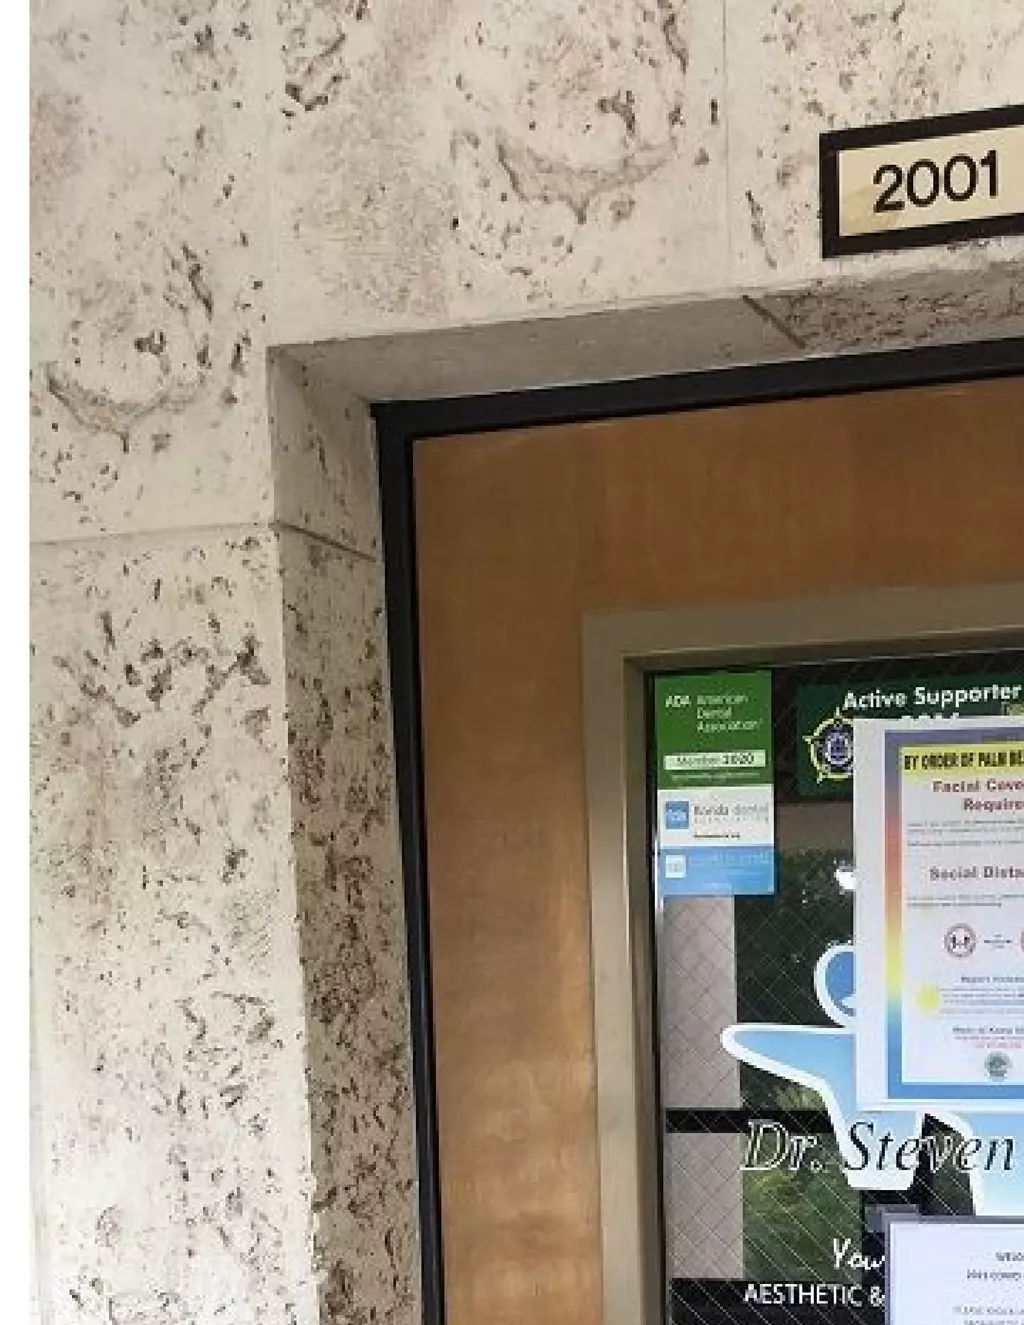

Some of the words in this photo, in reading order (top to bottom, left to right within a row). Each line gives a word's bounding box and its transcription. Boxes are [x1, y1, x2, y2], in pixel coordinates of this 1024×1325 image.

[873, 149, 997, 214] 2001
[664, 695, 691, 708] ADA
[844, 690, 907, 709] Active
[914, 684, 1022, 708] Supporter
[904, 755, 920, 770] BY
[921, 753, 959, 768] ORDER
[961, 752, 975, 767] OF
[977, 751, 1008, 767] PALM
[932, 779, 980, 793] Facial
[929, 866, 977, 881] Social
[740, 1118, 823, 1173] Dr.
[844, 1121, 1014, 1173] Steven
[833, 1238, 885, 1269] You
[744, 1283, 863, 1307] AESTHETIC
[869, 1286, 885, 1307] &
